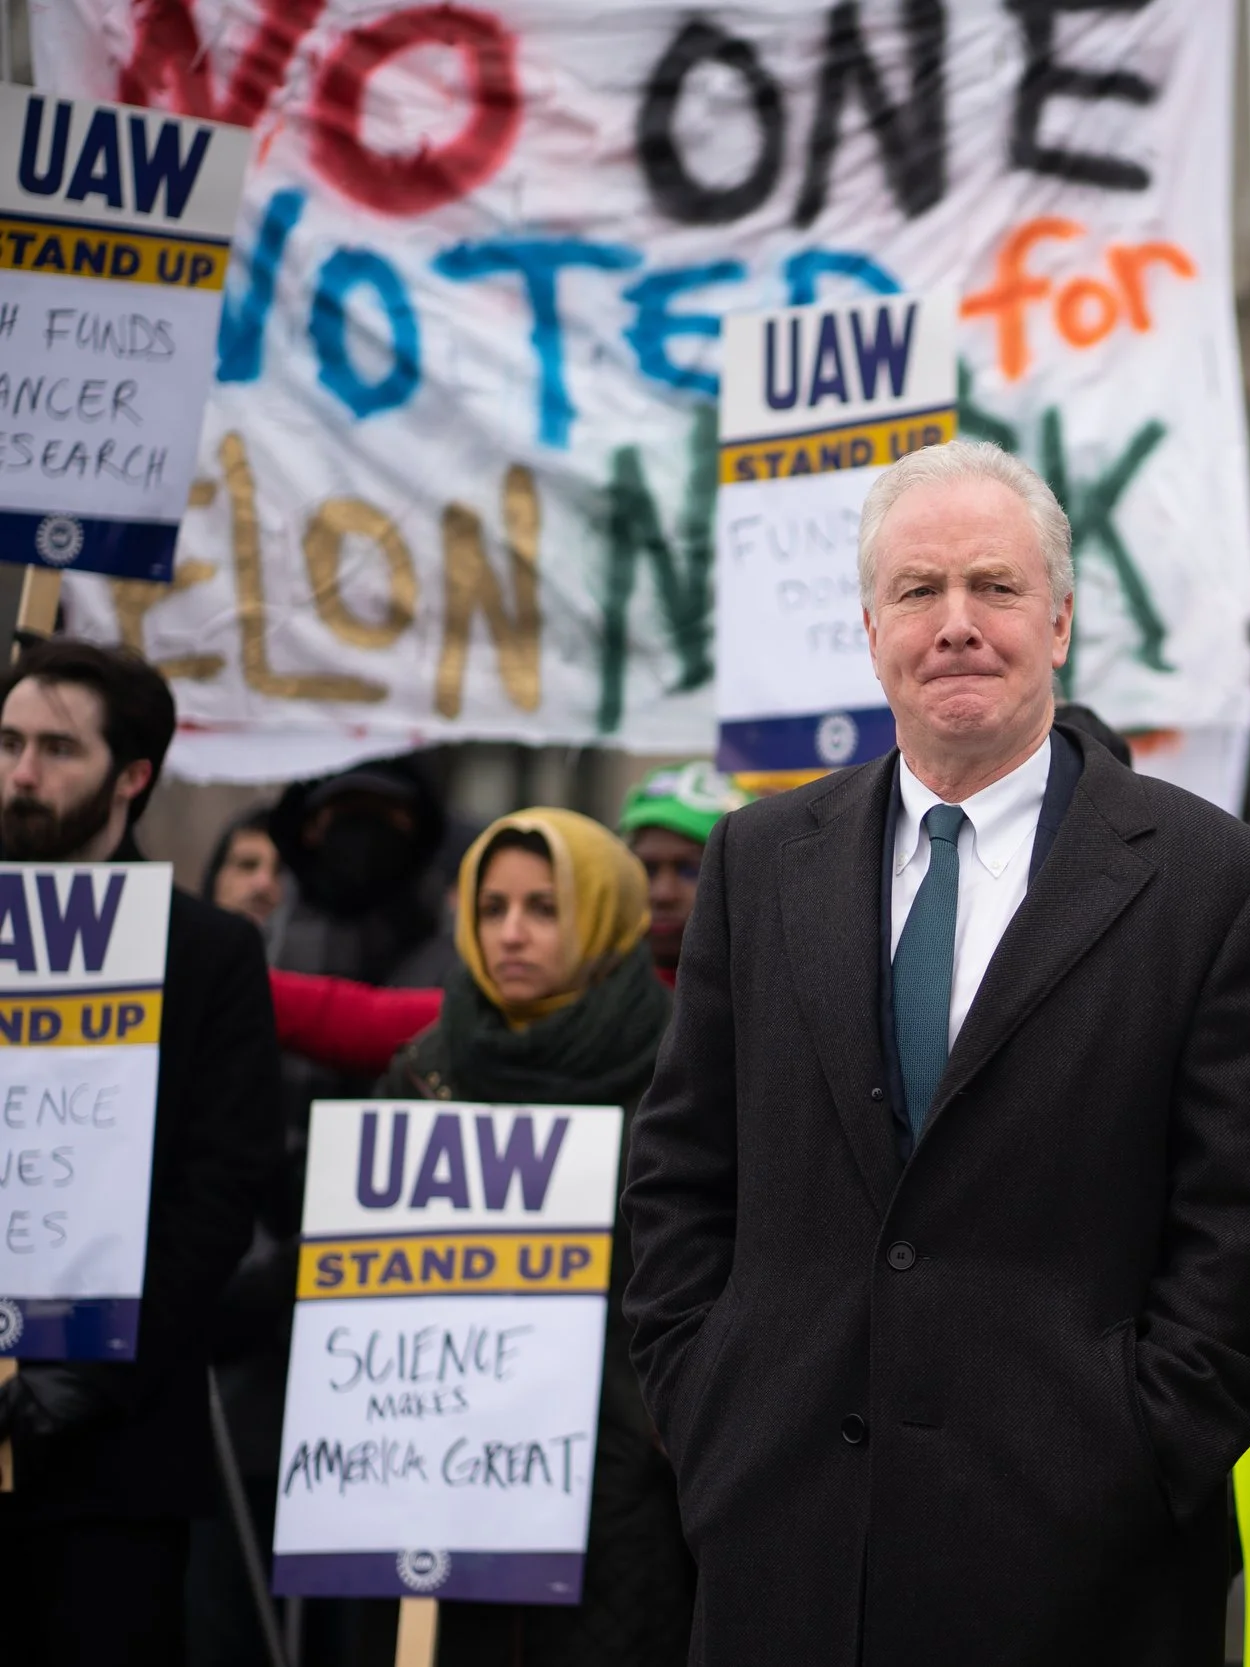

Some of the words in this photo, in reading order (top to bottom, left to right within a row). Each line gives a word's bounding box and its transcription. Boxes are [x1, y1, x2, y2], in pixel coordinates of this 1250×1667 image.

[636, 0, 1157, 230] ONE
[17, 94, 214, 220] UAW
[0, 230, 142, 277] TAND
[157, 247, 216, 287] UP
[958, 216, 1196, 382] for
[43, 307, 177, 363] FUNDS
[764, 302, 918, 411] UAW
[734, 437, 874, 483] STAND
[890, 422, 944, 461] UP
[80, 1001, 147, 1042] UP
[354, 1108, 572, 1213] UAW
[315, 1242, 497, 1290] STAND
[518, 1243, 594, 1284] UP
[324, 1324, 534, 1393] SCIENCE
[366, 1385, 471, 1424] MAKES
[284, 1434, 429, 1499] AMERICA
[441, 1431, 588, 1496] GREAT
